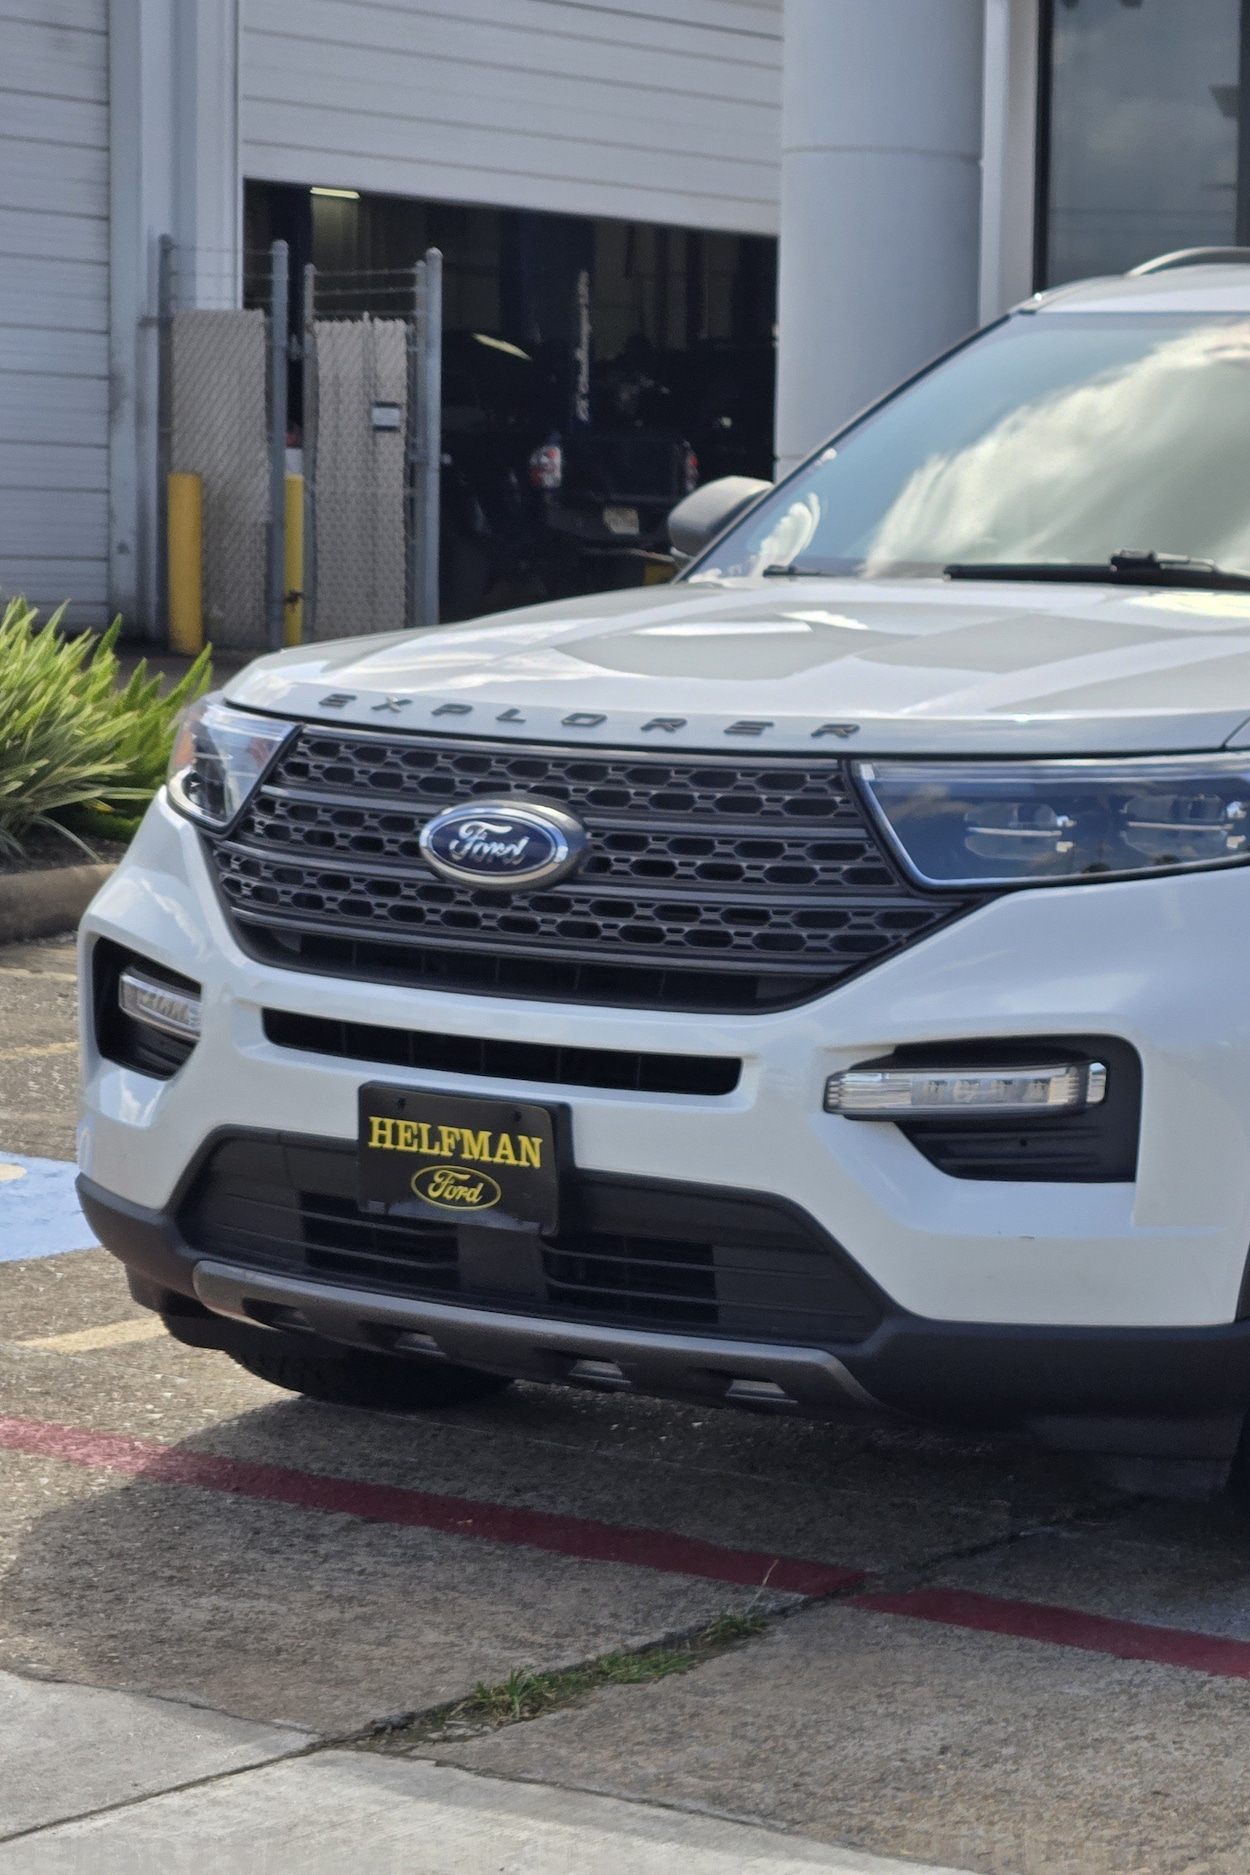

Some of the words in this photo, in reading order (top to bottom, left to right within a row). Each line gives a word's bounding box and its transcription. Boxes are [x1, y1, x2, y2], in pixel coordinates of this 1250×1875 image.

[318, 692, 861, 738] EXPLORER
[449, 820, 530, 866] Ford
[368, 1116, 543, 1169] HELFMAN
[427, 1169, 485, 1204] Ford
